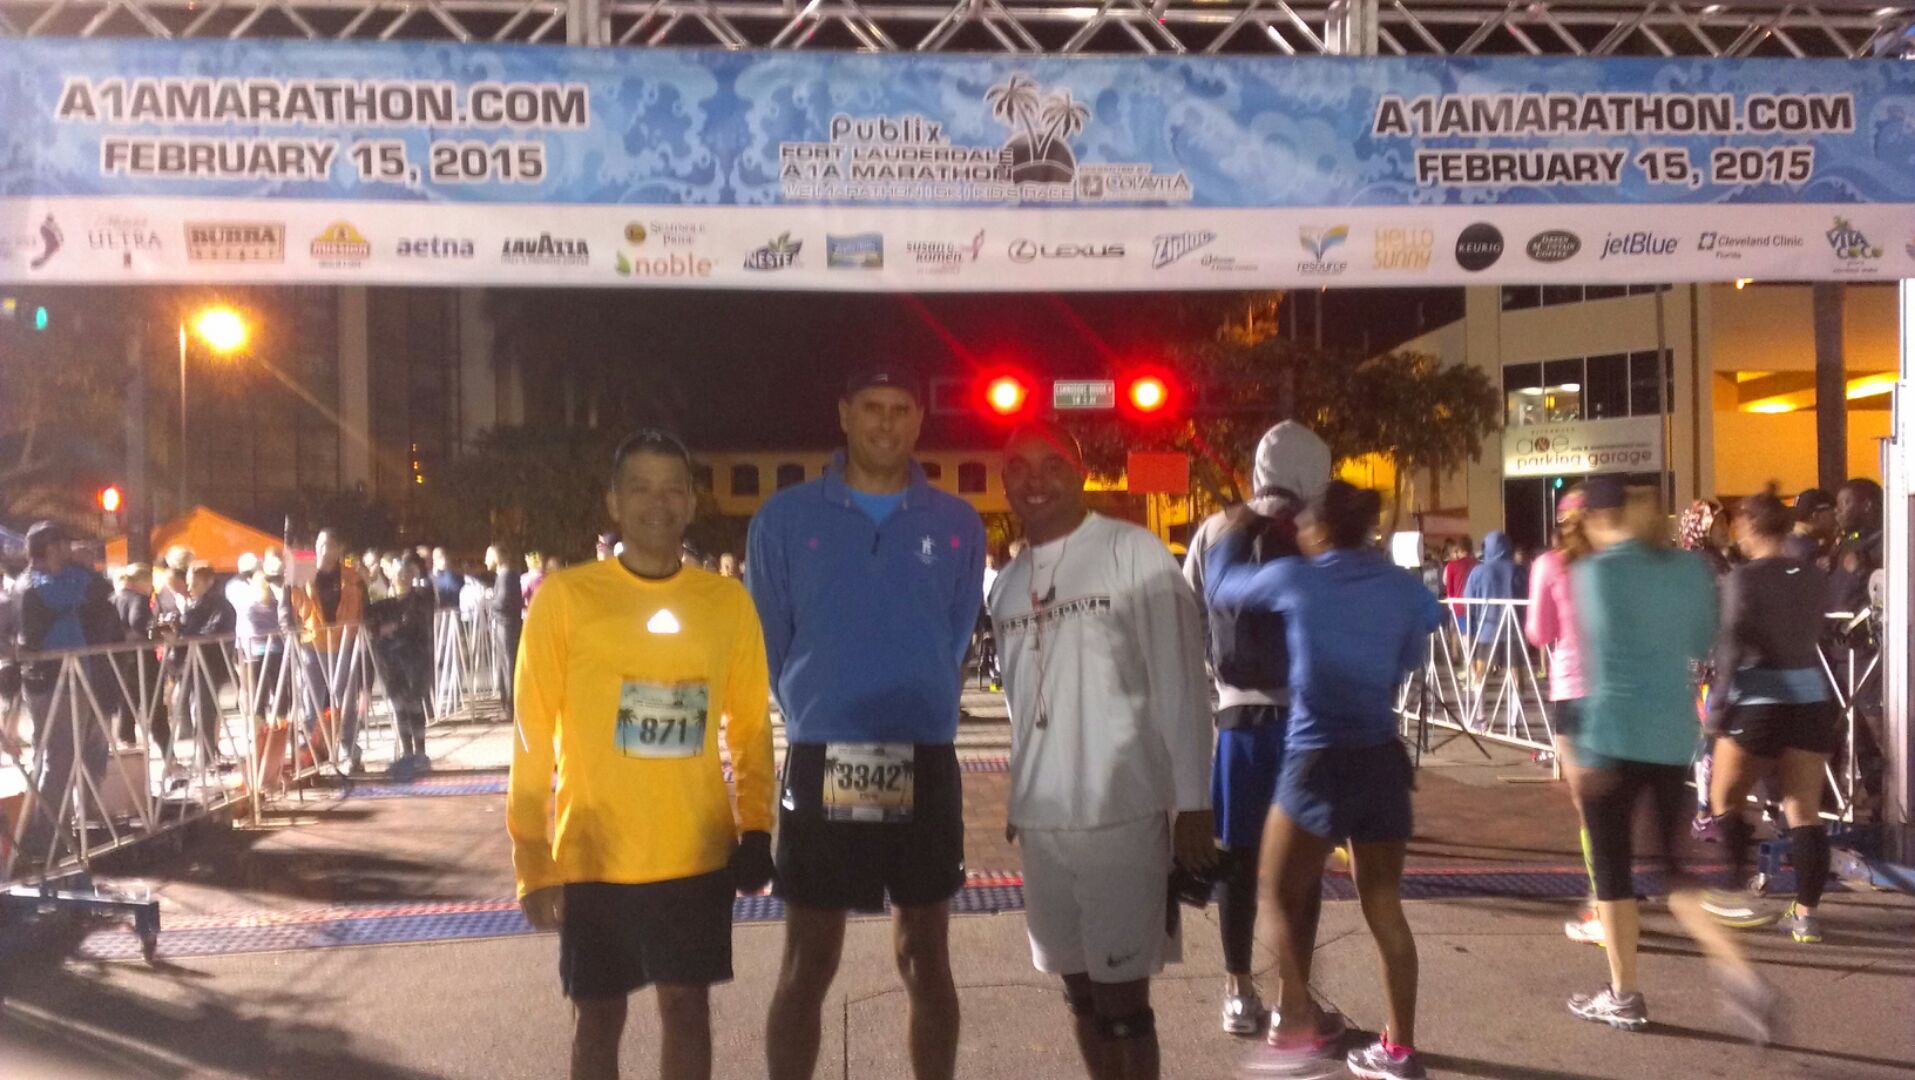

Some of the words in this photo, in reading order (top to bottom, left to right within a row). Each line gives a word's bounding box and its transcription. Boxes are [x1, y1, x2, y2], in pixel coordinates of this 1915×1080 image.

[57, 78, 588, 126] A1AMARATHON.COM
[1373, 93, 1854, 135] A1AMARATHON.COM
[831, 115, 942, 143] Publix
[103, 141, 335, 178] FEBRUARY
[351, 142, 418, 184] 15,
[432, 144, 545, 180] 2015
[781, 146, 845, 160] FORT
[852, 147, 1014, 164] LAUDERDALE
[1417, 150, 1624, 184] FEBRUARY
[1638, 151, 1702, 187] 15,
[1715, 150, 1814, 182] 2015
[782, 163, 842, 178] A1A
[852, 164, 1014, 182] MARATHON
[88, 229, 162, 250] ULTRA
[397, 236, 475, 258] aetna
[1040, 244, 1125, 259] LEXUS
[1457, 242, 1501, 254] KEURIG
[1600, 231, 1678, 260] jetBlue
[1718, 235, 1769, 248] Cleveland
[1772, 235, 1803, 248] Clinic
[635, 251, 713, 278] noble
[1517, 452, 1581, 469] parking
[1588, 451, 1653, 468] garage
[639, 718, 688, 746] 871
[837, 762, 901, 792] 3342
